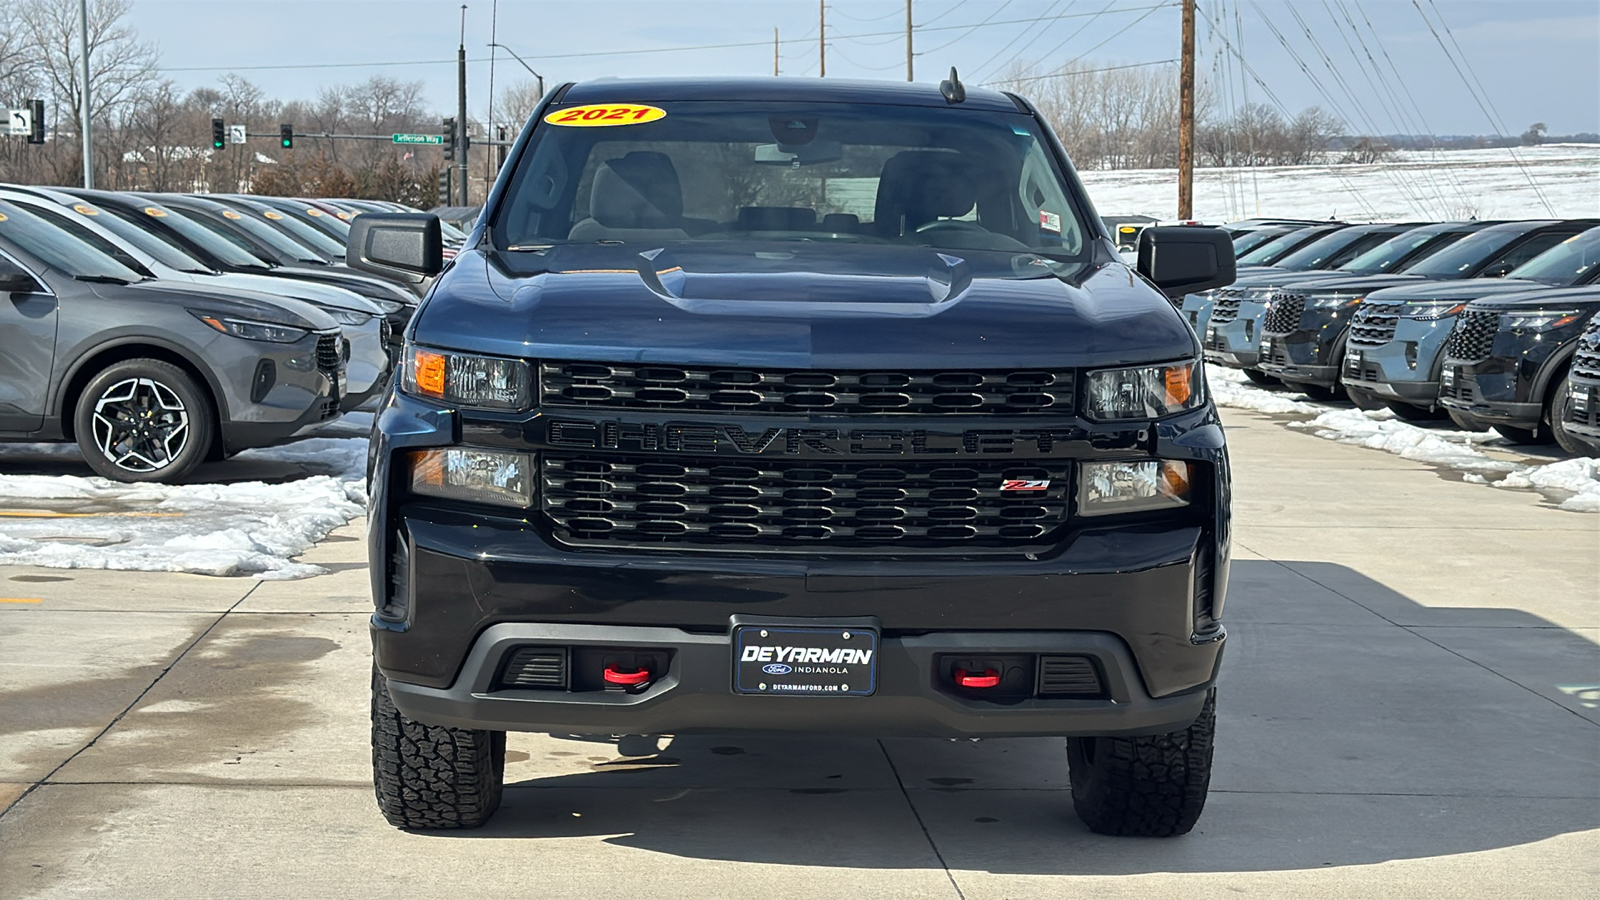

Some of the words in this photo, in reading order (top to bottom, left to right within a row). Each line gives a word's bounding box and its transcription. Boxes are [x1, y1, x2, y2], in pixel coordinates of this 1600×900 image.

[556, 108, 652, 122] 2021
[426, 135, 439, 143] Way
[546, 418, 1075, 455] CHEVROLET
[999, 479, 1050, 490] Z71
[741, 645, 873, 664] DEYARMAN
[766, 664, 788, 674] Ford
[794, 666, 849, 674] INDIANOLA
